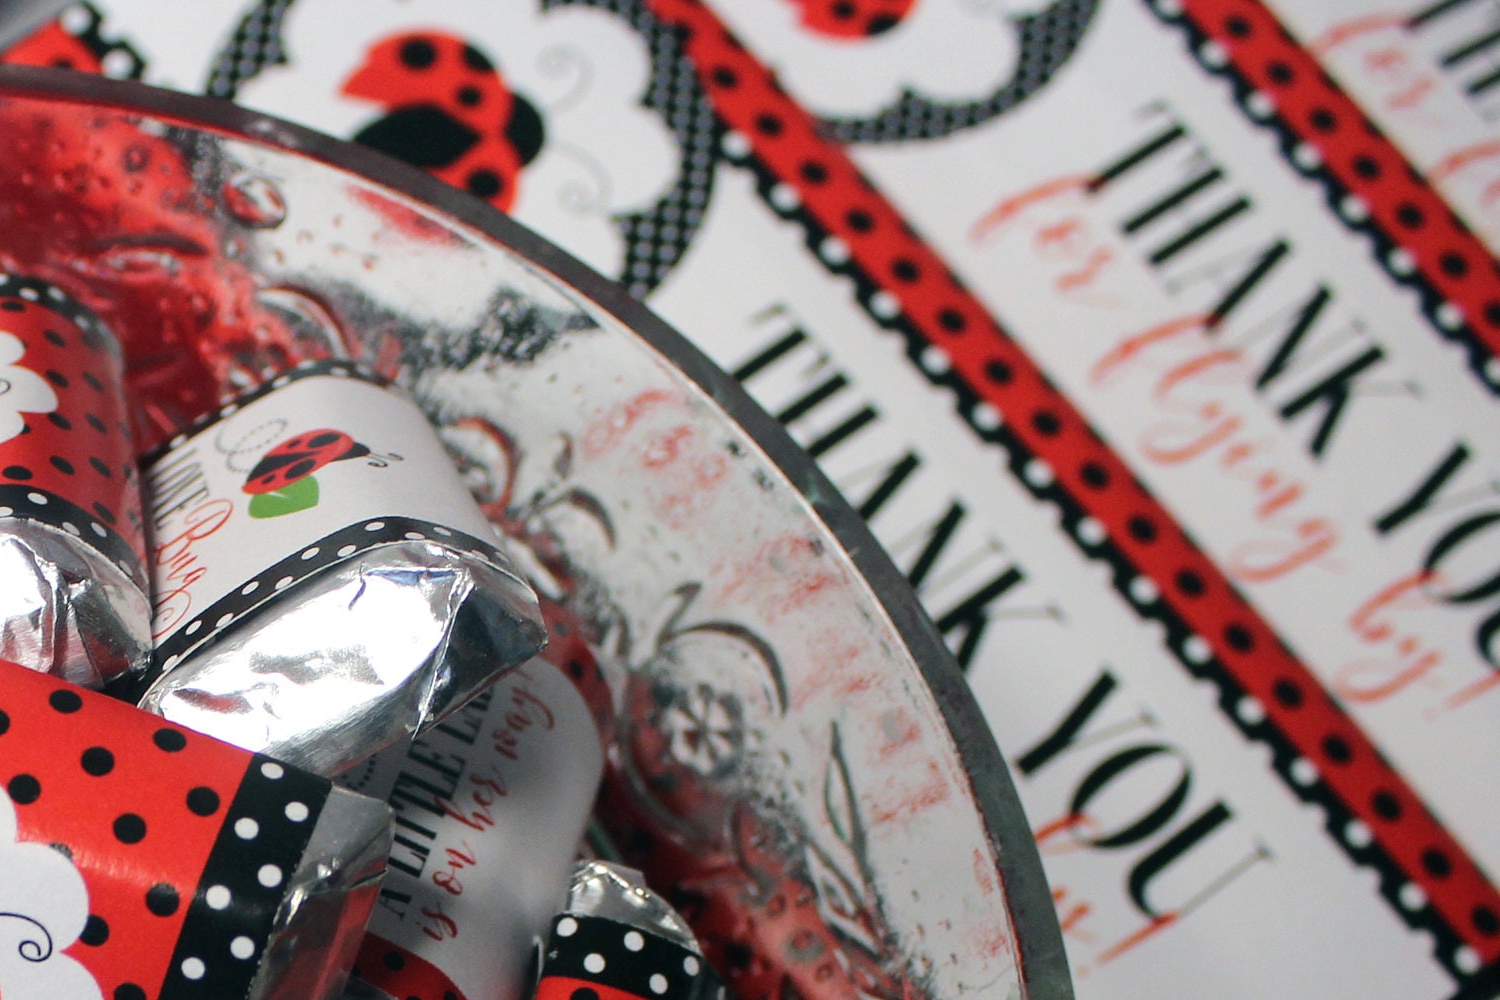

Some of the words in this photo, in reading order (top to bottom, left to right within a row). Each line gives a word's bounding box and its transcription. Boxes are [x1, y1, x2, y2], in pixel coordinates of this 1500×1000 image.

[1084, 100, 1428, 462] THANK
[153, 498, 234, 640] Bug
[730, 303, 1070, 678] THANK
[1015, 668, 1276, 924] YOU
[434, 766, 508, 832] her
[432, 840, 476, 896] on
[416, 904, 458, 942] is
